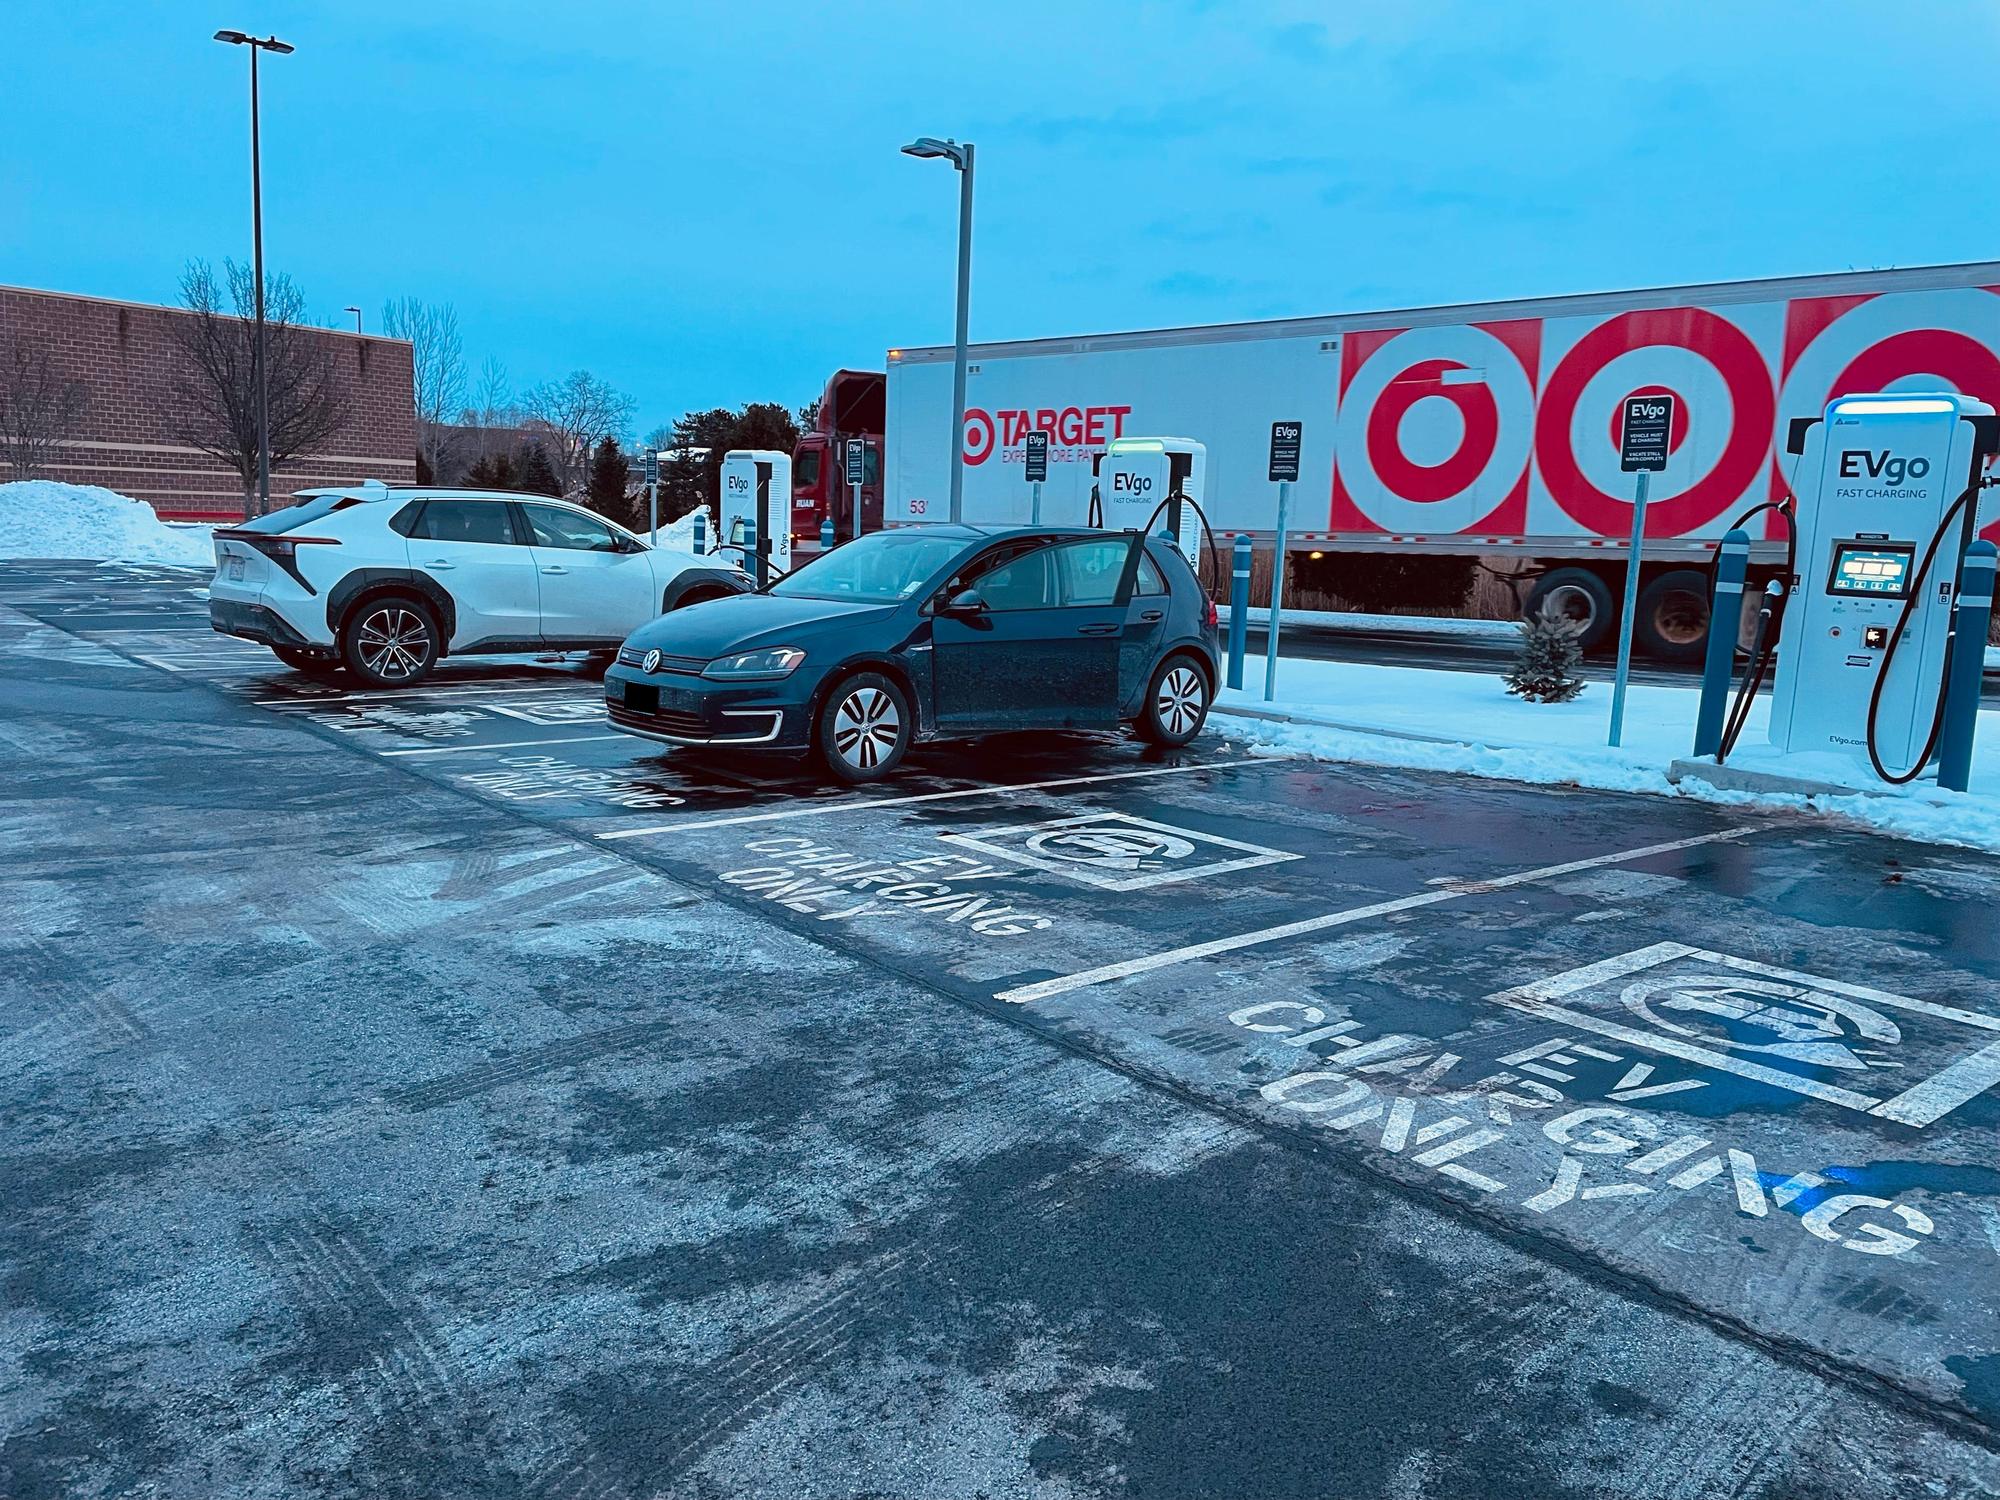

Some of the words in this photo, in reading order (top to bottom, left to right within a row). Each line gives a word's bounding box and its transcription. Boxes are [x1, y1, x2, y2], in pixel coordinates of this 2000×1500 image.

[1631, 404, 1666, 419] EVgo
[997, 406, 1132, 447] TARGET
[1275, 426, 1298, 439] EVgo
[1029, 435, 1046, 447] EVgo
[1839, 449, 1931, 487] EVgo
[728, 476, 749, 493] EVgo
[1114, 472, 1152, 496] EVgo
[1836, 488, 1863, 498] FAST
[1865, 489, 1927, 499] CHARGING
[780, 533, 789, 556] EVgo
[1790, 586, 1798, 594] A
[1940, 594, 1949, 603] B
[1829, 735, 1868, 746] EVgo.com
[460, 772, 583, 800] ONLY
[498, 755, 686, 809] CHARGING
[897, 854, 1019, 881] EV
[718, 867, 898, 921] ONLY
[744, 838, 1052, 937] CHARGING
[1495, 1037, 1711, 1102] EV
[1228, 1000, 1935, 1256] CHARGING
[1259, 1071, 1656, 1214] ONLY
